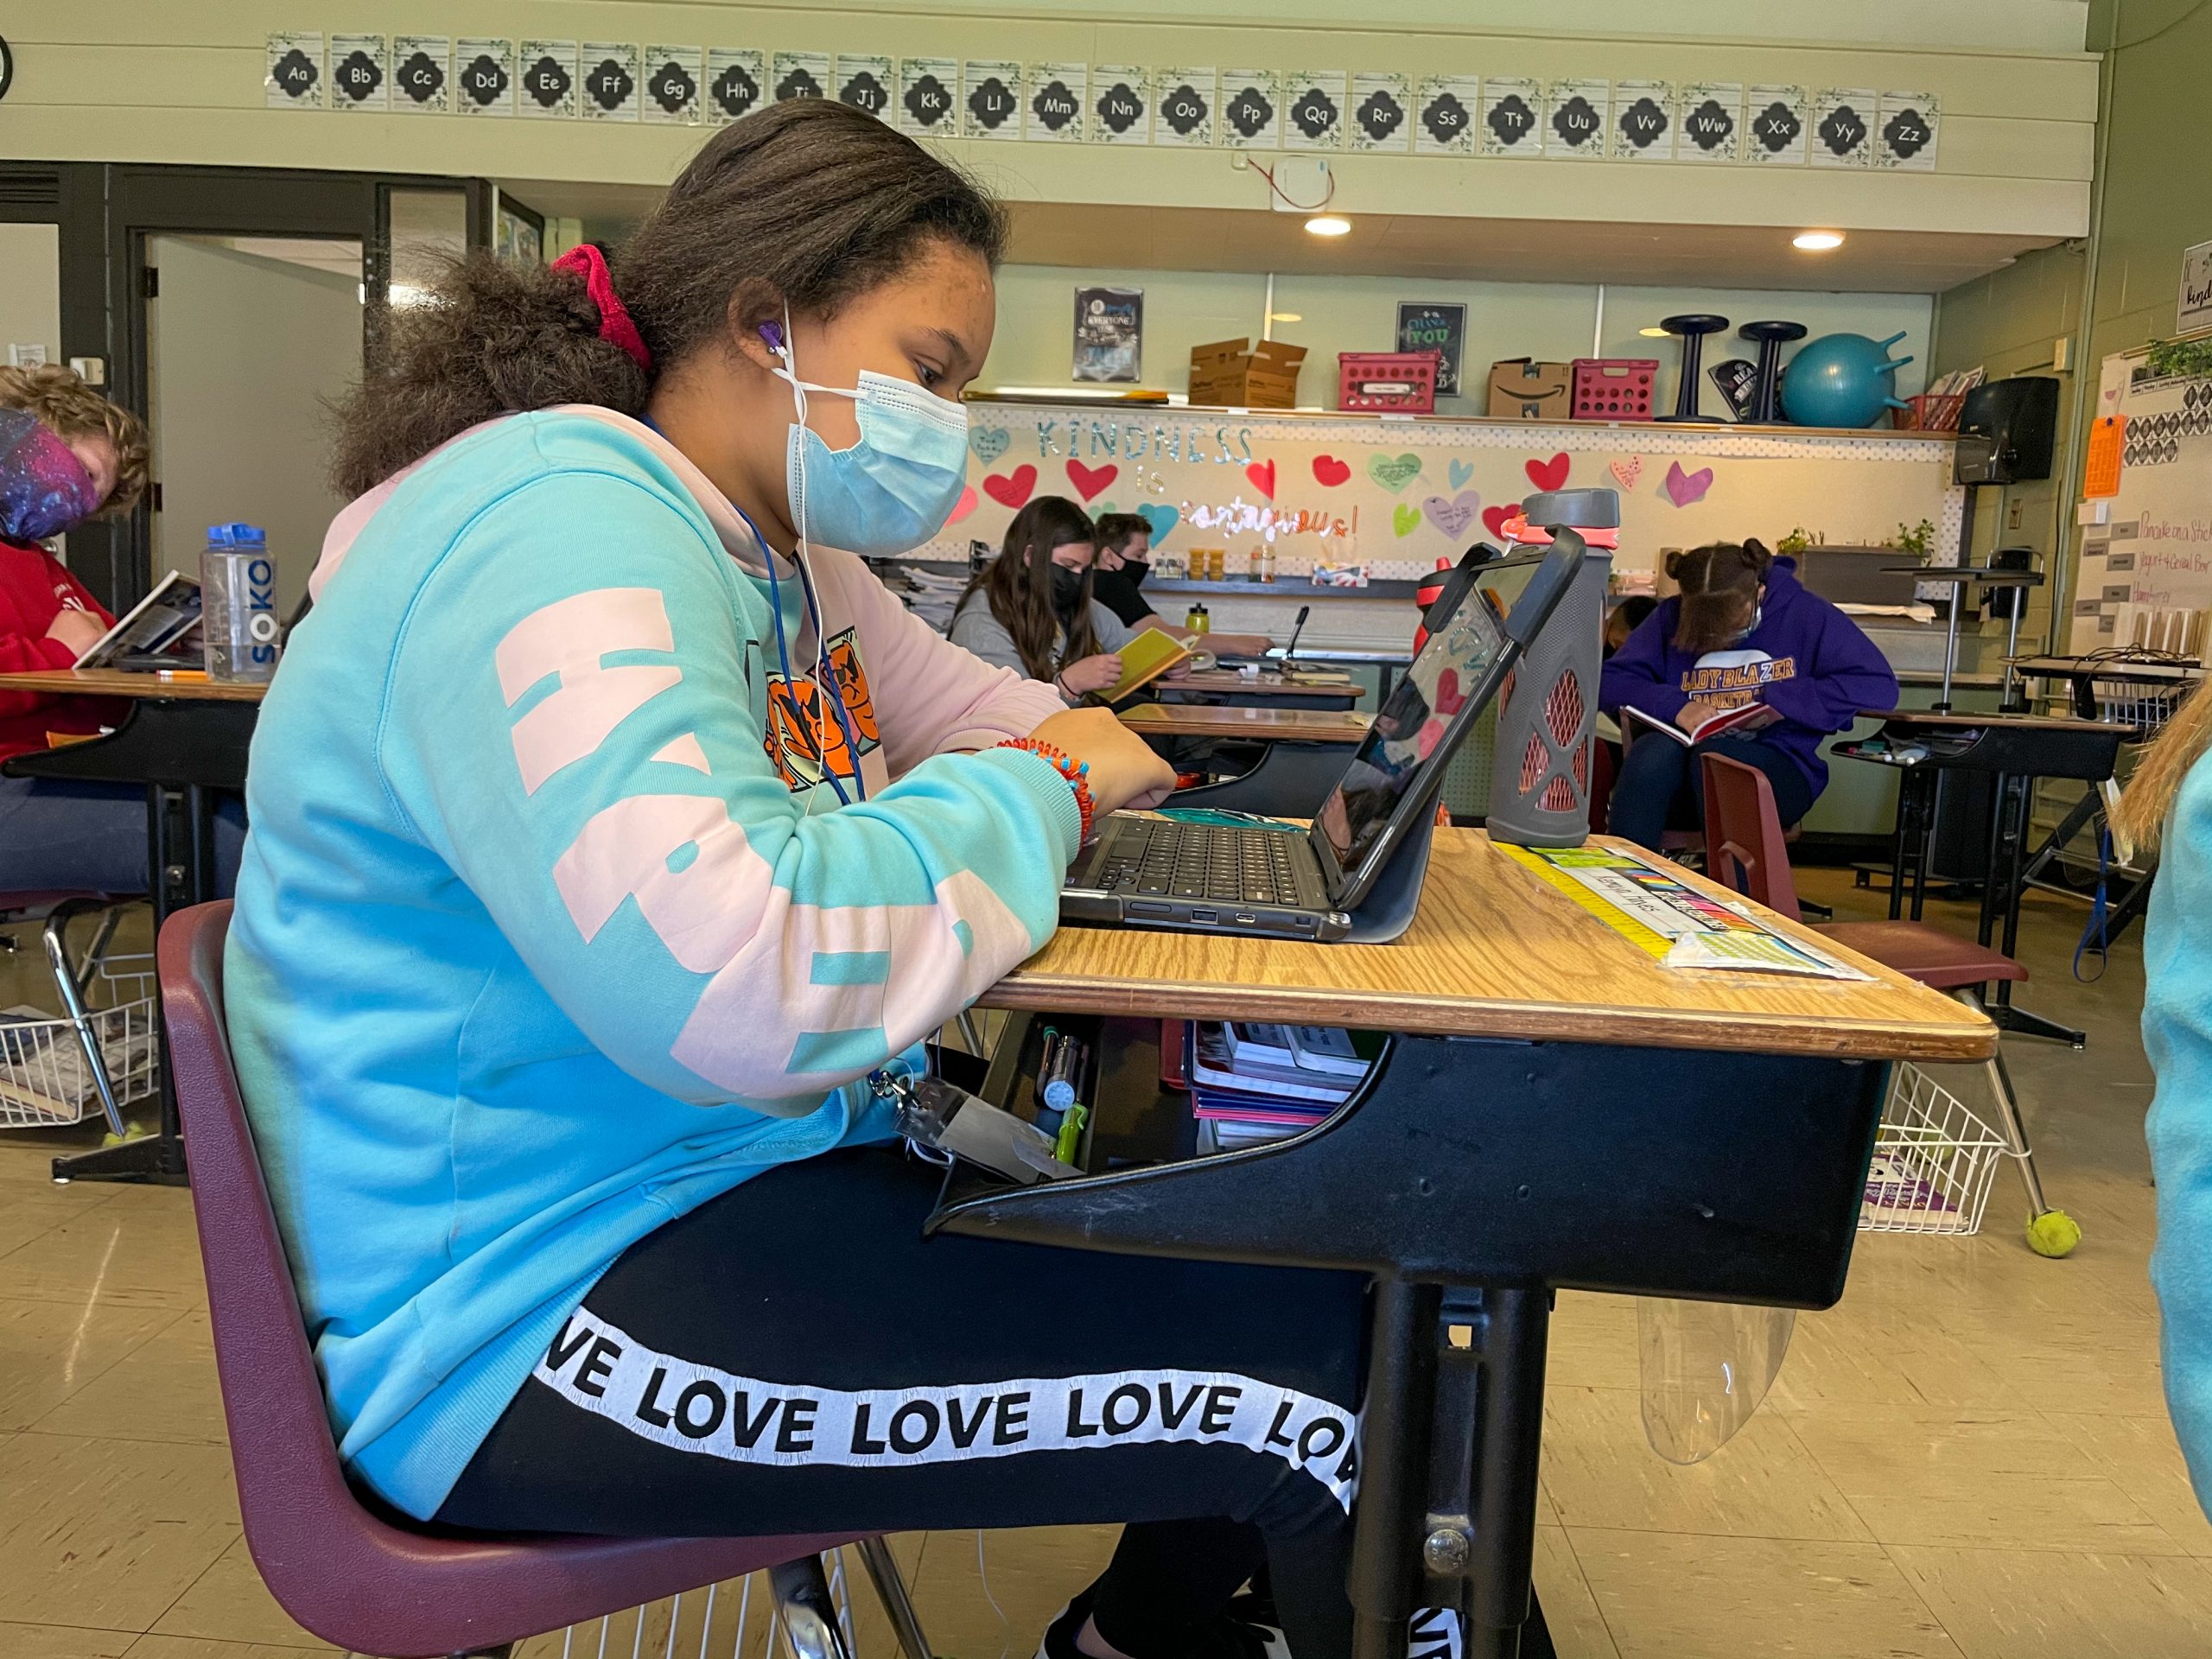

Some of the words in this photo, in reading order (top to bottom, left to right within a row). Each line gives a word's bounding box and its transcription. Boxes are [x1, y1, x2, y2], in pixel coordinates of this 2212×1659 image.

[288, 67, 308, 81] Aa
[351, 67, 372, 84] Bb
[412, 69, 432, 86] Cc
[475, 72, 498, 88] Dd
[539, 73, 560, 90] Ee
[602, 76, 621, 93] Ff
[664, 79, 685, 100] Gg
[726, 82, 749, 99] Hh
[856, 89, 875, 110] Jj
[920, 92, 941, 108] Kk
[1044, 98, 1071, 114] Mm
[1111, 99, 1134, 116] Nn
[1175, 102, 1198, 118] Oo
[1243, 104, 1262, 124] Pp
[1305, 105, 1328, 125] Qq
[1372, 107, 1392, 123] Rr
[1437, 111, 1458, 126] Ss
[1504, 111, 1523, 127] Tt
[1567, 113, 1590, 130] Uu
[1637, 114, 1656, 130] Vv
[1697, 117, 1726, 133] Ww
[1767, 118, 1790, 135] Xx
[1834, 123, 1855, 143] Yy
[1897, 125, 1920, 142] Zz
[1409, 328, 1450, 345] YOU
[1037, 421, 1252, 467] KINDNESS
[1135, 465, 1165, 495] is
[248, 559, 277, 664] SOKO
[1681, 669, 1722, 691] LADY
[1722, 657, 1795, 688] BLAZER
[545, 1316, 622, 1398] VE
[636, 1367, 819, 1453] LOVE
[849, 1390, 1032, 1456] LOVE
[1065, 1382, 1243, 1440] LOVE
[1263, 1402, 1356, 1483] LO
